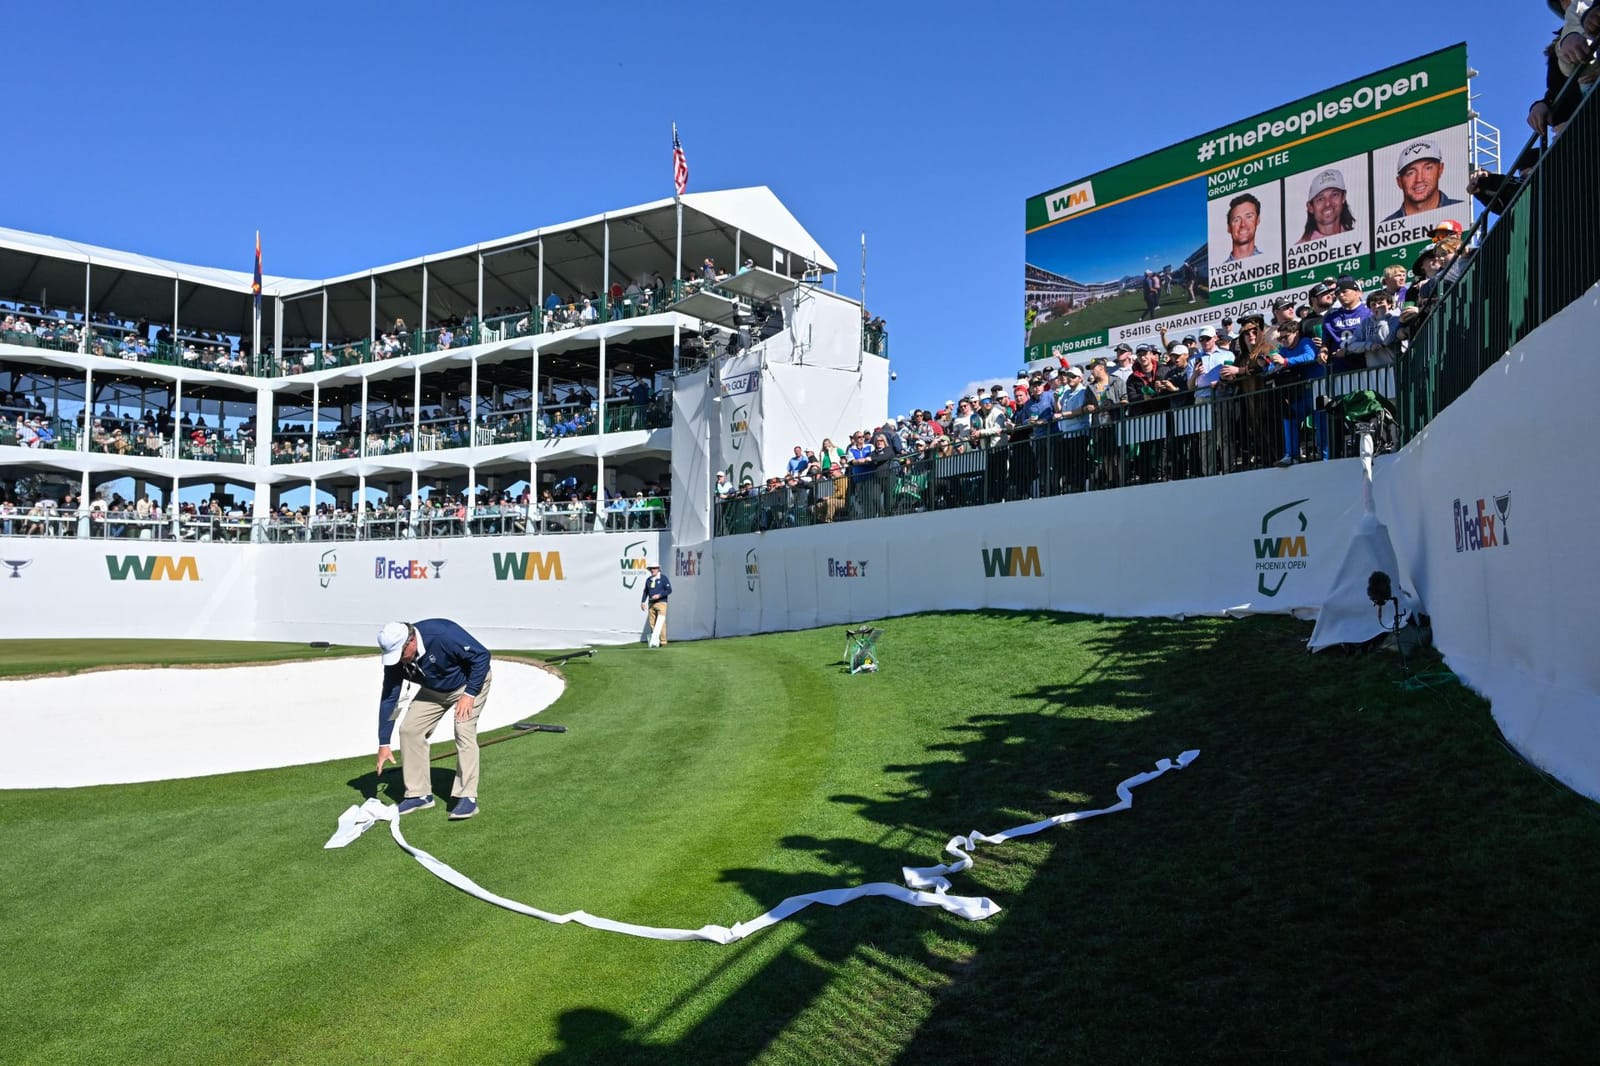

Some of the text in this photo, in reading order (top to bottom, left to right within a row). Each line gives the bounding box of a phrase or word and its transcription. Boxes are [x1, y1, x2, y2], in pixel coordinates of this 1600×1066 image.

[1197, 71, 1429, 163] #ThePeoplesOpen
[1208, 151, 1290, 187] NOW ON TEE
[1208, 178, 1248, 197] GROUP 22
[1052, 190, 1088, 213] WM
[1376, 219, 1406, 235] ALEX
[1376, 224, 1434, 249] NOREN
[1288, 239, 1327, 257] AARON
[1288, 242, 1363, 271] BADDELEY
[1392, 248, 1407, 259] -3
[1210, 261, 1242, 277] TYSON
[1210, 262, 1280, 289] ALEXANDER
[1301, 259, 1360, 281] -4 T46
[1221, 279, 1274, 299] -3 T56
[1119, 291, 1308, 340] $54116 GUARANTEED 50/50 JAKPO
[1052, 336, 1103, 354] 50/50 RAFFLE
[732, 378, 747, 390] GOLF
[725, 461, 754, 487] 16
[1463, 498, 1498, 551] FedEx
[1254, 536, 1308, 559] WM
[106, 555, 200, 581] WM
[319, 563, 336, 572] WM
[388, 560, 428, 579] FedEx
[493, 551, 564, 580] WM
[620, 559, 647, 569] WM
[836, 560, 858, 577] FedEx
[981, 546, 1041, 577] WM
[1256, 560, 1306, 571] PHOENIX OPEN
